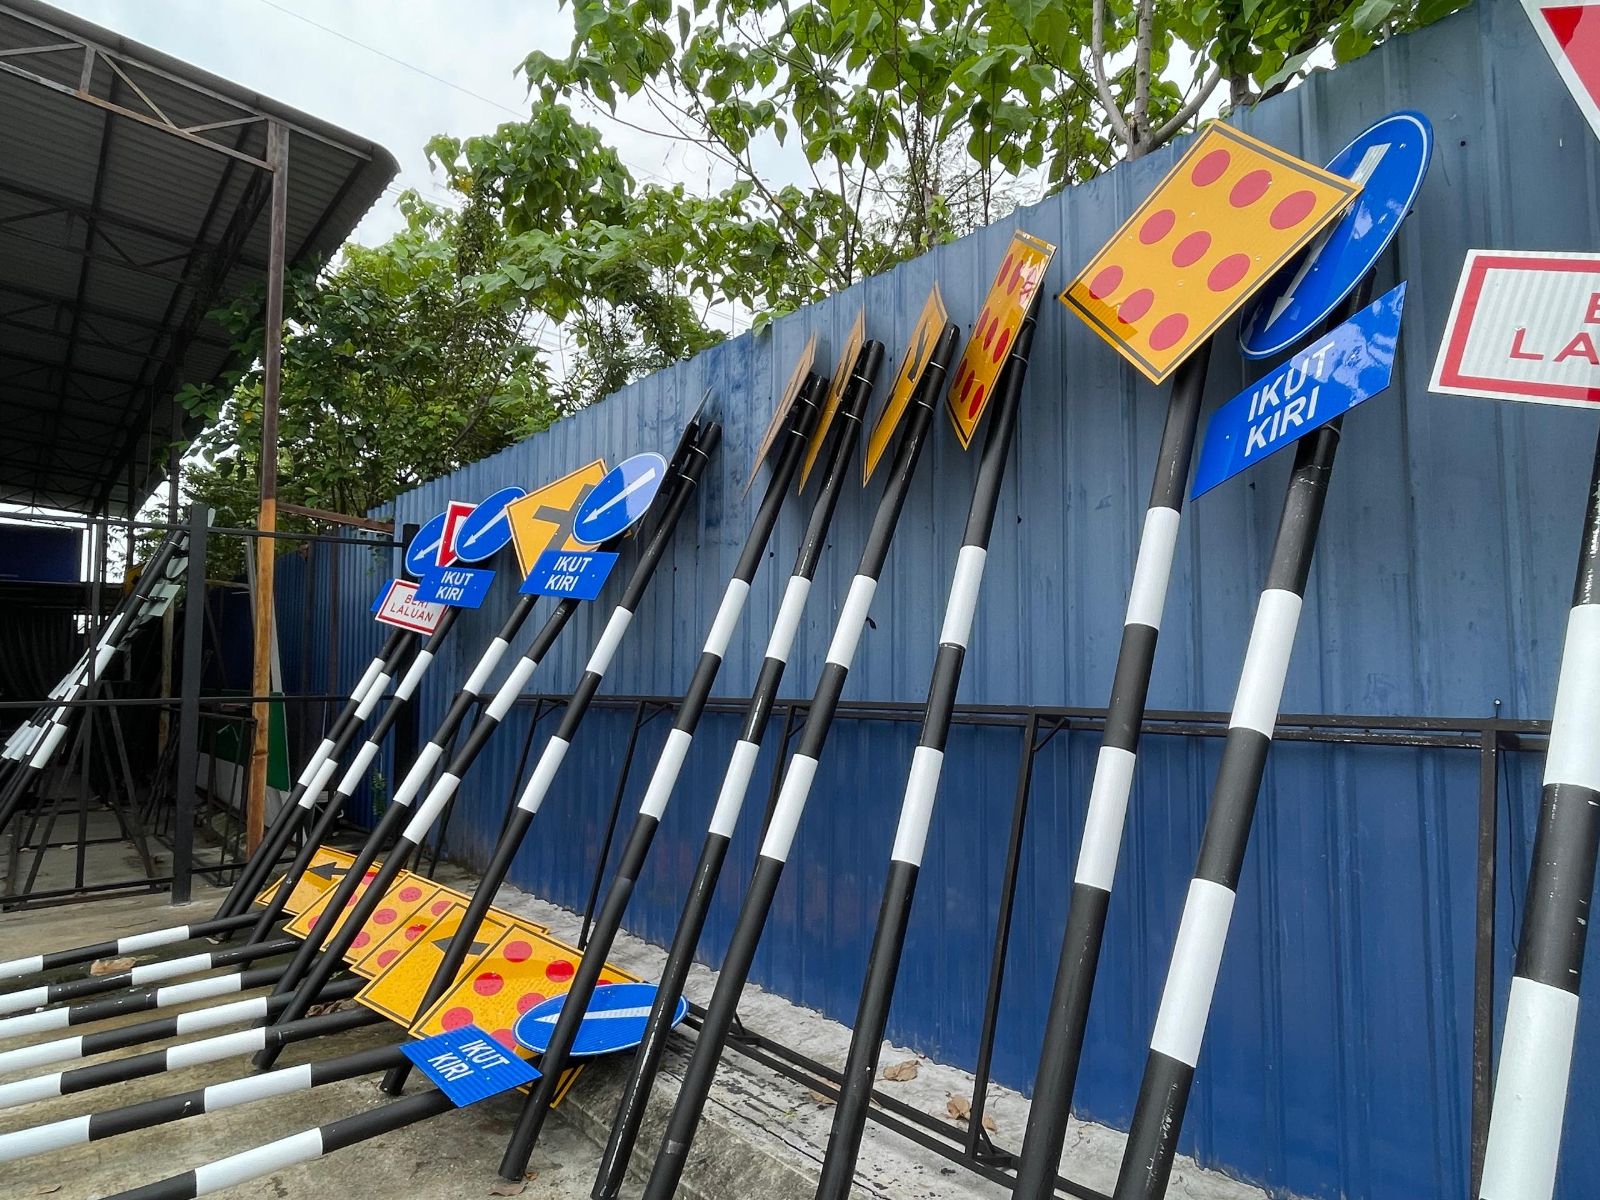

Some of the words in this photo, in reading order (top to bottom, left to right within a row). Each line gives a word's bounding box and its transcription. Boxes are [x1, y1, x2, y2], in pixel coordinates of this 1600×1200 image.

[1248, 341, 1335, 422] IKUT
[1244, 386, 1320, 457] KIRI
[553, 556, 592, 573] IKUT
[441, 571, 474, 586] IKUT
[544, 574, 579, 592] KIRI
[435, 586, 465, 601] KIRI
[390, 603, 433, 622] LALUAN
[458, 1039, 511, 1069] IKUT
[427, 1052, 475, 1082] KIRI
